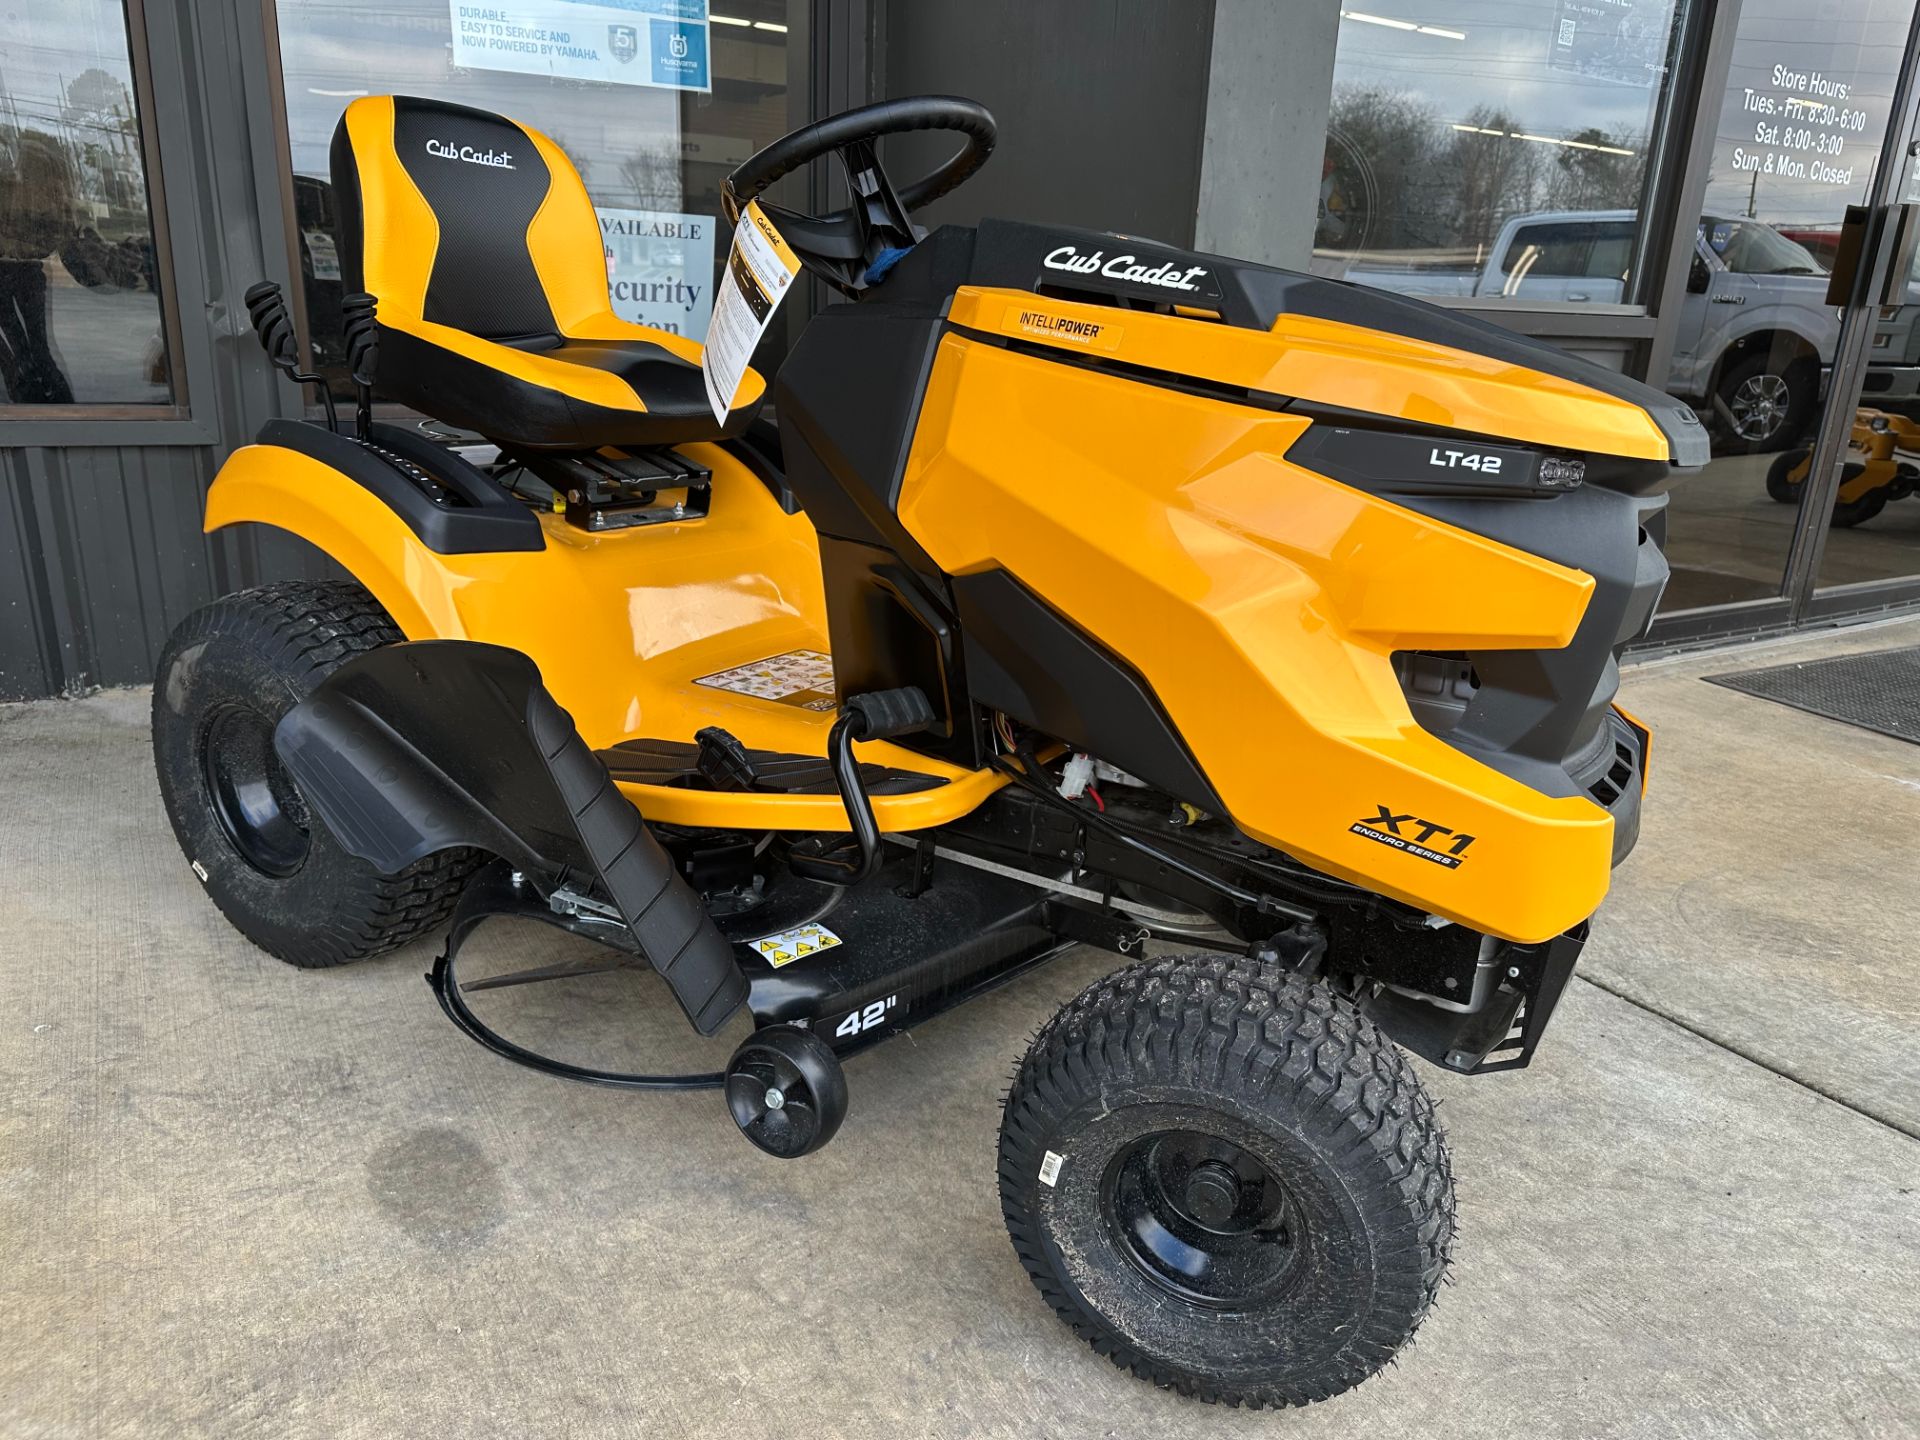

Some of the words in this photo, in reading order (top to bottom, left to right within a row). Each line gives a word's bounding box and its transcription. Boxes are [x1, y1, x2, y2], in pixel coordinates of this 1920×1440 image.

[461, 20, 487, 34] EASY
[490, 24, 503, 36] TO
[505, 26, 547, 41] SERVICE
[549, 31, 570, 44] AND
[462, 35, 486, 48] NOW
[489, 38, 538, 54] POWERED
[540, 44, 554, 55] BY
[556, 46, 600, 61] YAMAHA.
[660, 56, 698, 69] Husqvarna
[1772, 64, 1807, 91] Store
[1809, 72, 1852, 100] Hours:
[1754, 121, 1779, 146] Sat.
[425, 139, 459, 160] Cub
[460, 146, 513, 169] Cadet
[1732, 147, 1762, 172] Sun.
[1763, 152, 1774, 174] &
[1776, 154, 1806, 179] Mon.
[1810, 160, 1853, 185] Closed
[601, 218, 702, 240] VAILABLE
[1044, 246, 1104, 274] Cub
[1101, 255, 1207, 290] Cadet
[608, 276, 702, 311] curity
[1050, 330, 1091, 344] PERFORMANCE
[1429, 448, 1502, 474] LT42
[1352, 825, 1405, 848] ENDURO
[1358, 804, 1476, 856] XT1
